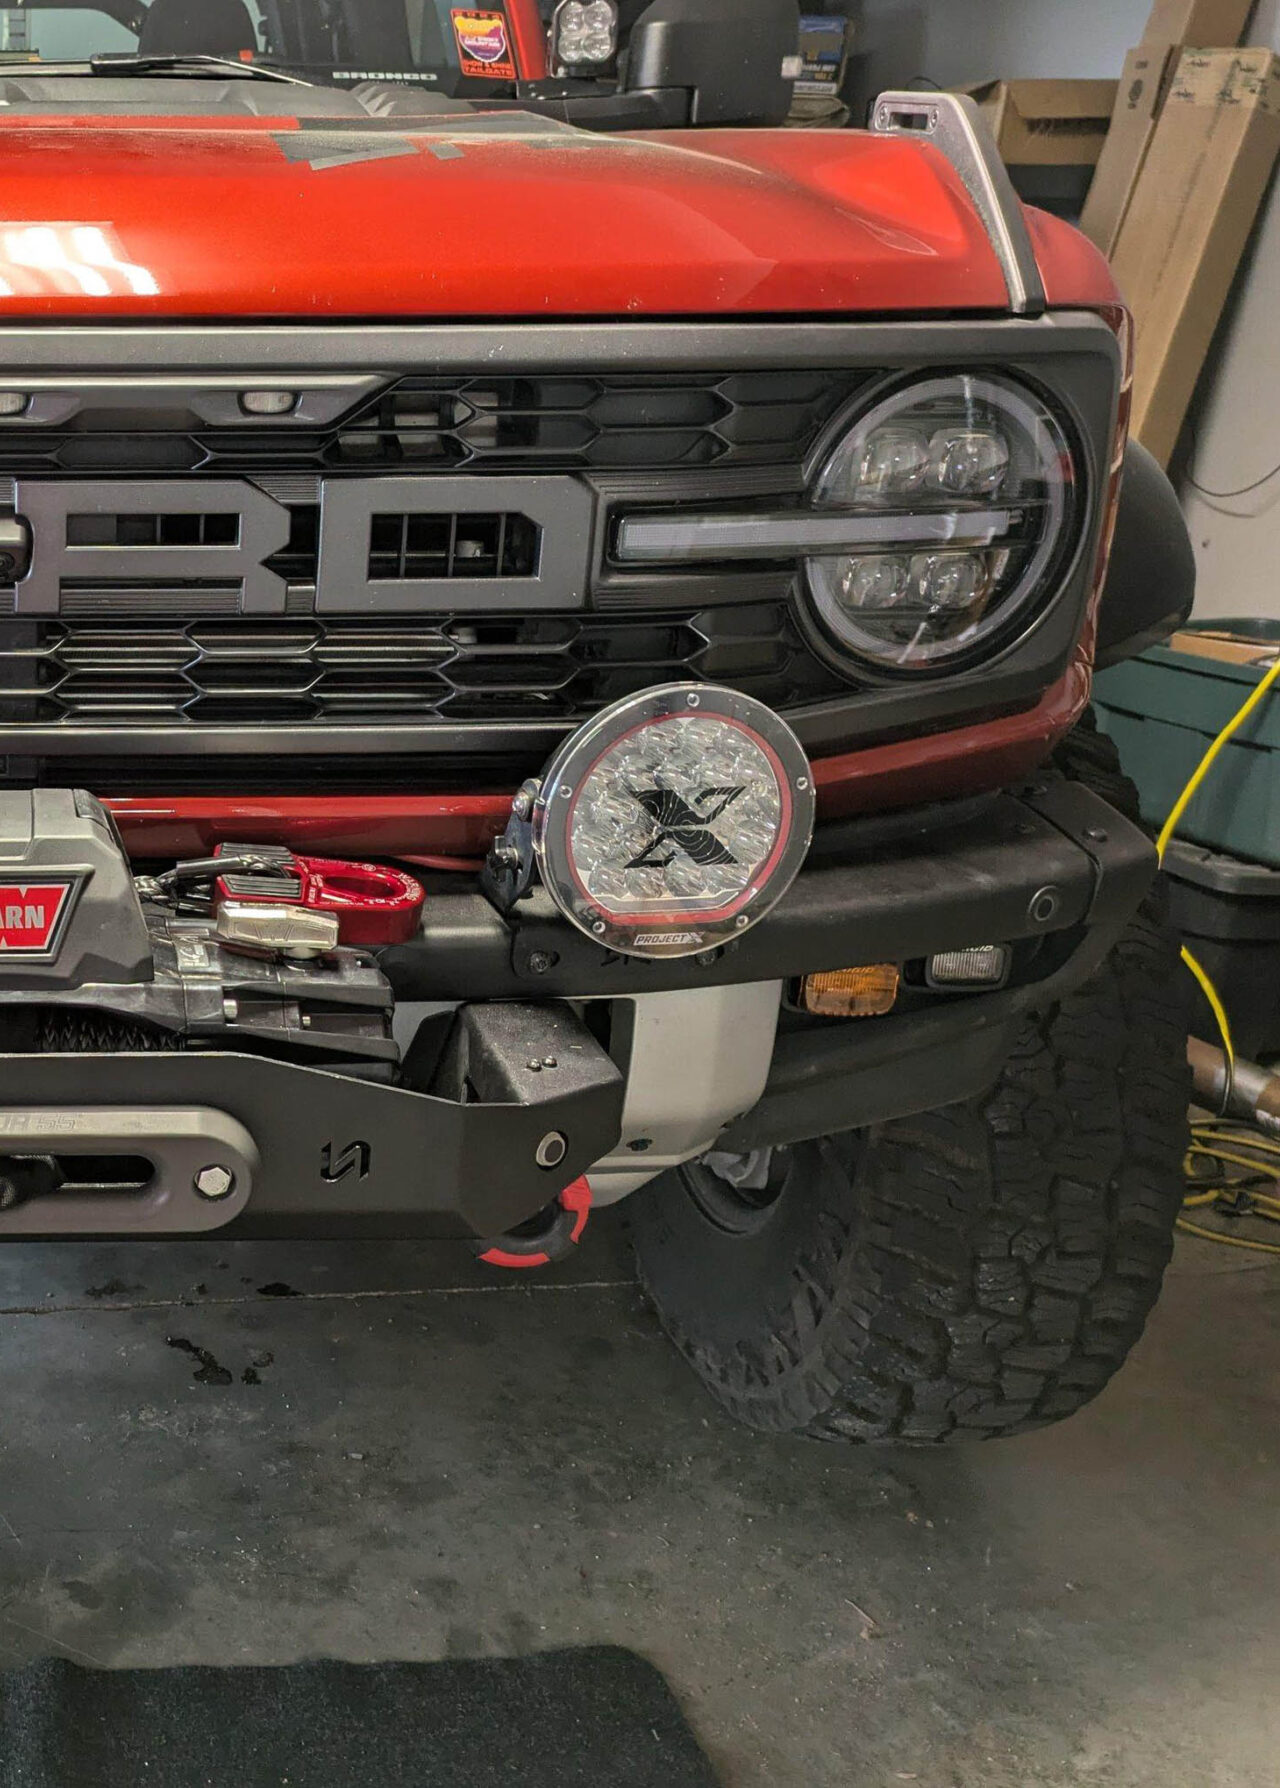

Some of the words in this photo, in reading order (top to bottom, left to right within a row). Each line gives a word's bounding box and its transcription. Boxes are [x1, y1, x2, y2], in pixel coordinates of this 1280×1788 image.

[464, 67, 513, 75] TAILGATE
[332, 72, 437, 80] BRONCO
[635, 934, 688, 944] PROJECT
[37, 1115, 76, 1131] 55
